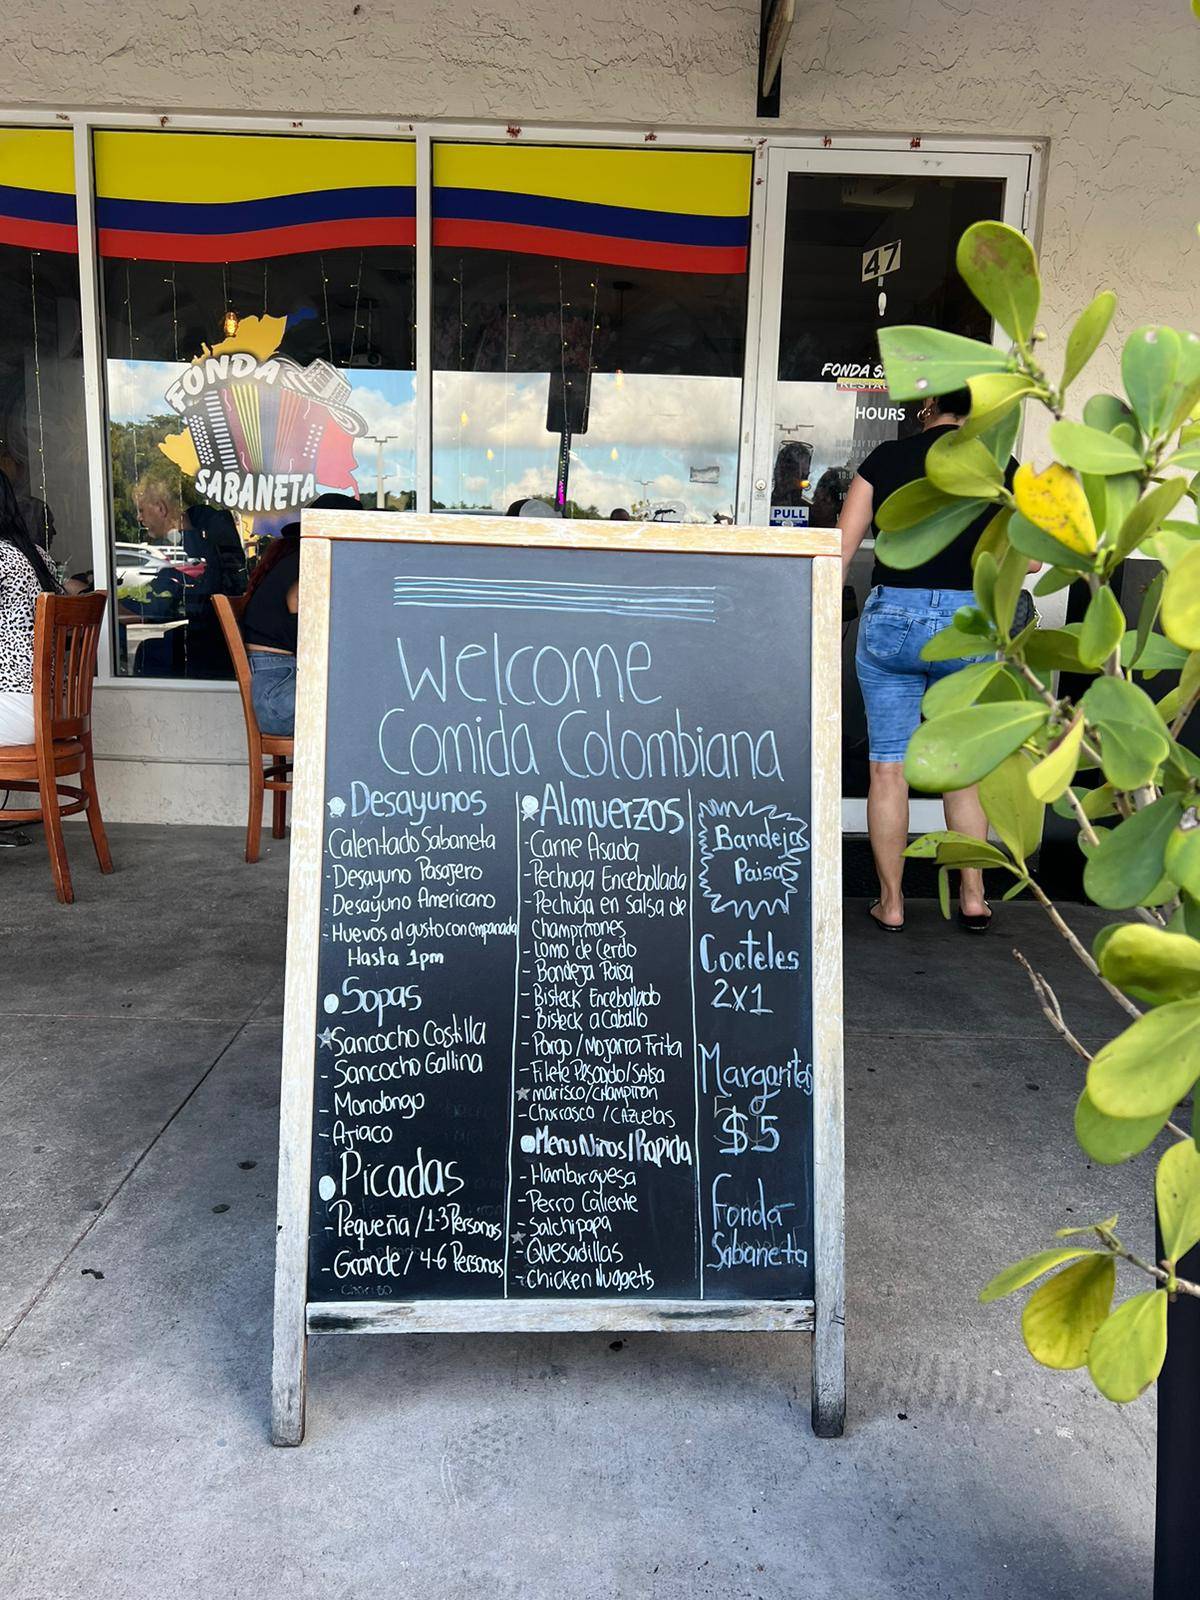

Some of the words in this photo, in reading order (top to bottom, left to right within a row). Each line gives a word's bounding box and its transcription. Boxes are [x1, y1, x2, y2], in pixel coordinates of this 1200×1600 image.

[863, 242, 900, 279] 47
[164, 353, 281, 413] FONDA
[821, 362, 870, 378] FONDA
[855, 406, 906, 421] HOURS
[195, 468, 315, 512] SABANETA
[774, 509, 806, 519] PULL
[396, 632, 662, 706] Welcome
[378, 707, 540, 777] Comida
[557, 707, 785, 782] Colombiana
[350, 780, 487, 826] Desayunos
[540, 780, 685, 834] Almuerzos
[328, 826, 420, 859] Calentado
[421, 823, 496, 852] Sabaneta
[530, 829, 583, 858] Carne
[587, 831, 639, 862] Asada
[712, 816, 804, 859] Bandeja
[332, 864, 412, 899] Desayuno
[529, 858, 595, 899] Pechuga
[601, 863, 687, 891] Encebollada
[734, 857, 785, 885] Paisa
[332, 892, 412, 922] Desayuno
[417, 886, 496, 909] Americano
[532, 889, 595, 921] Pechuga
[600, 896, 619, 914] en
[625, 892, 664, 918] Salsa
[669, 896, 687, 917] de
[332, 922, 388, 943] Huevos
[391, 920, 404, 940] al
[405, 917, 443, 947] gusto
[575, 939, 592, 960] de
[596, 938, 637, 960] Cerdo
[347, 946, 400, 967] Hasta
[406, 949, 444, 971] 1pm
[700, 929, 800, 973] Cocteles
[599, 960, 634, 984] Paisa
[341, 976, 422, 1027] Sopas
[601, 1008, 648, 1029] Caballo
[331, 1024, 420, 1057] Sancocho
[423, 1013, 487, 1049] Costilla
[642, 1033, 683, 1058] Frita
[333, 1055, 421, 1089] Sancocho
[424, 1050, 484, 1074] Gallina
[530, 1060, 571, 1083] Filete
[697, 1041, 814, 1115] Margaritas
[334, 1090, 425, 1120] Mondongo
[529, 1103, 595, 1122] Churrasco
[535, 1125, 576, 1157] Menu
[719, 1105, 781, 1156] $5
[339, 1147, 465, 1199] Picadas
[531, 1162, 636, 1194] Hamburguesa
[526, 1189, 574, 1213] Perro
[582, 1190, 639, 1213] Caliente
[712, 1173, 785, 1231] Fonda
[328, 1199, 410, 1251] Pequeña
[446, 1203, 502, 1241] Personas
[333, 1245, 401, 1279] Grande
[449, 1240, 504, 1278] Personas
[526, 1237, 624, 1265] Quesadillas
[706, 1228, 808, 1271] Sabaneta
[526, 1269, 592, 1290] Chicken
[594, 1263, 655, 1291] Nuggets
